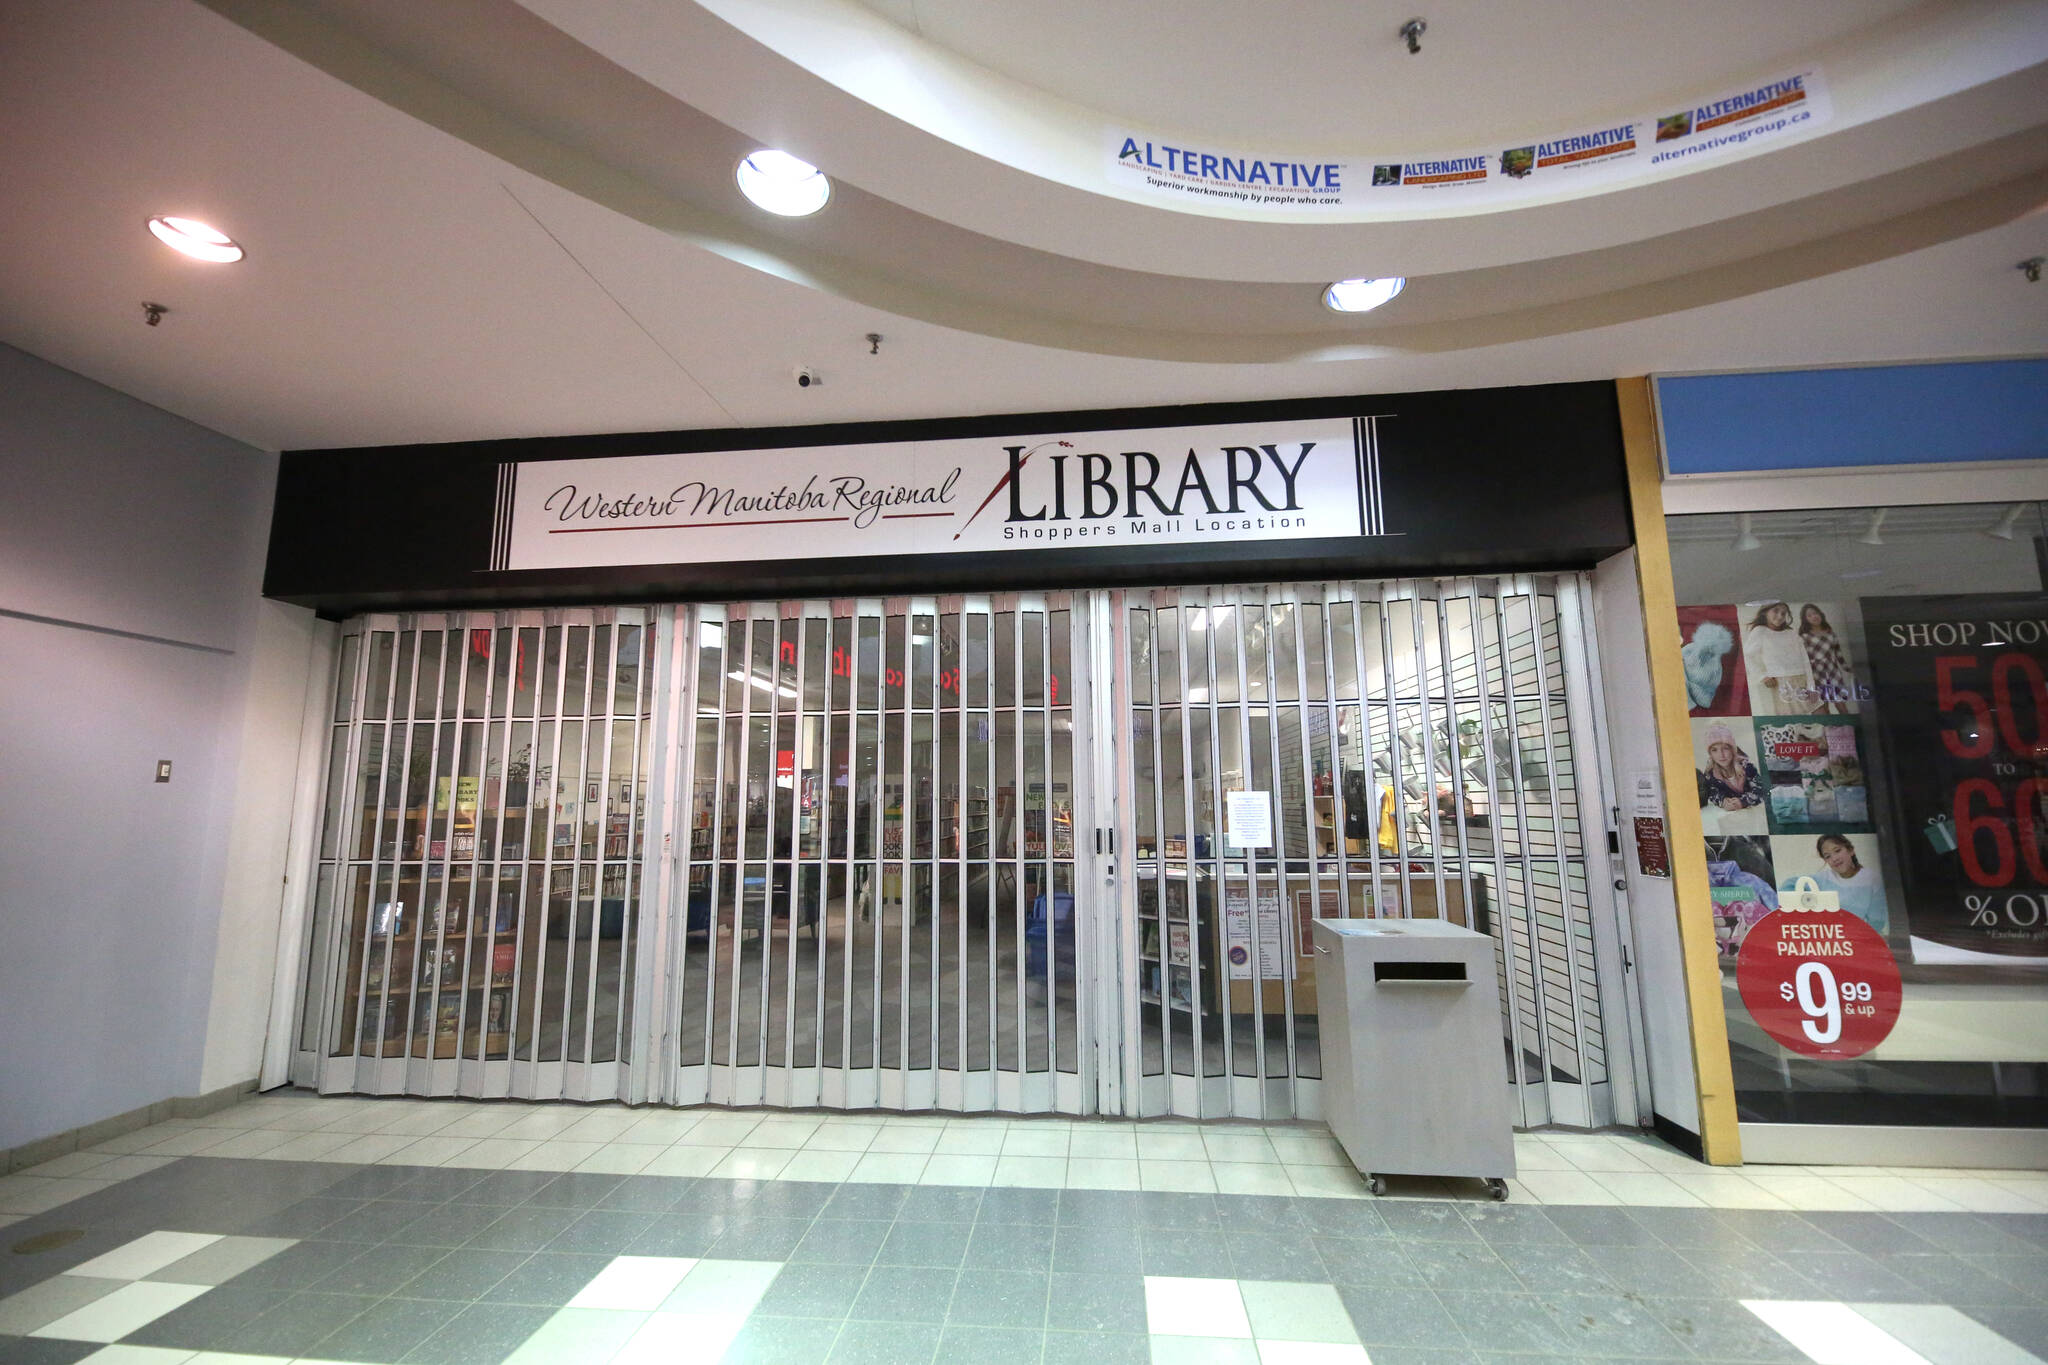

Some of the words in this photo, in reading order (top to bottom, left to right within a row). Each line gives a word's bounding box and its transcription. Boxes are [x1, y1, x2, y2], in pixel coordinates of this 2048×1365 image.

[1697, 75, 1805, 121] ALTERNATIVE
[1538, 125, 1635, 157] ALTERNATIVE
[1651, 110, 1811, 164] alternativegroup.ca
[1118, 137, 1341, 188] ALTERNATIVE
[1404, 155, 1486, 176] ALTERNATIVE
[1146, 176, 1184, 192] Superior
[1186, 185, 1249, 201] workmanship
[1250, 192, 1262, 203] by
[1264, 195, 1295, 205] people
[1297, 196, 1317, 205] who
[1319, 198, 1343, 206] care.
[1002, 442, 1317, 523] LIBRARY
[544, 484, 676, 521] Western
[671, 475, 828, 517] Manitoba
[830, 467, 962, 529] Regional
[1003, 524, 1116, 540] Shoppers
[1130, 519, 1180, 534] Mall
[1195, 515, 1307, 531] Location
[1889, 621, 1976, 648] SHOP
[1935, 653, 2048, 759] 50
[1992, 763, 2016, 775] TO
[1965, 895, 1998, 926] %
[1781, 924, 1845, 939] FESTIVE
[1777, 941, 1854, 957] PAJAMAS
[1844, 1003, 1856, 1015] &
[1857, 1005, 1876, 1018] up
